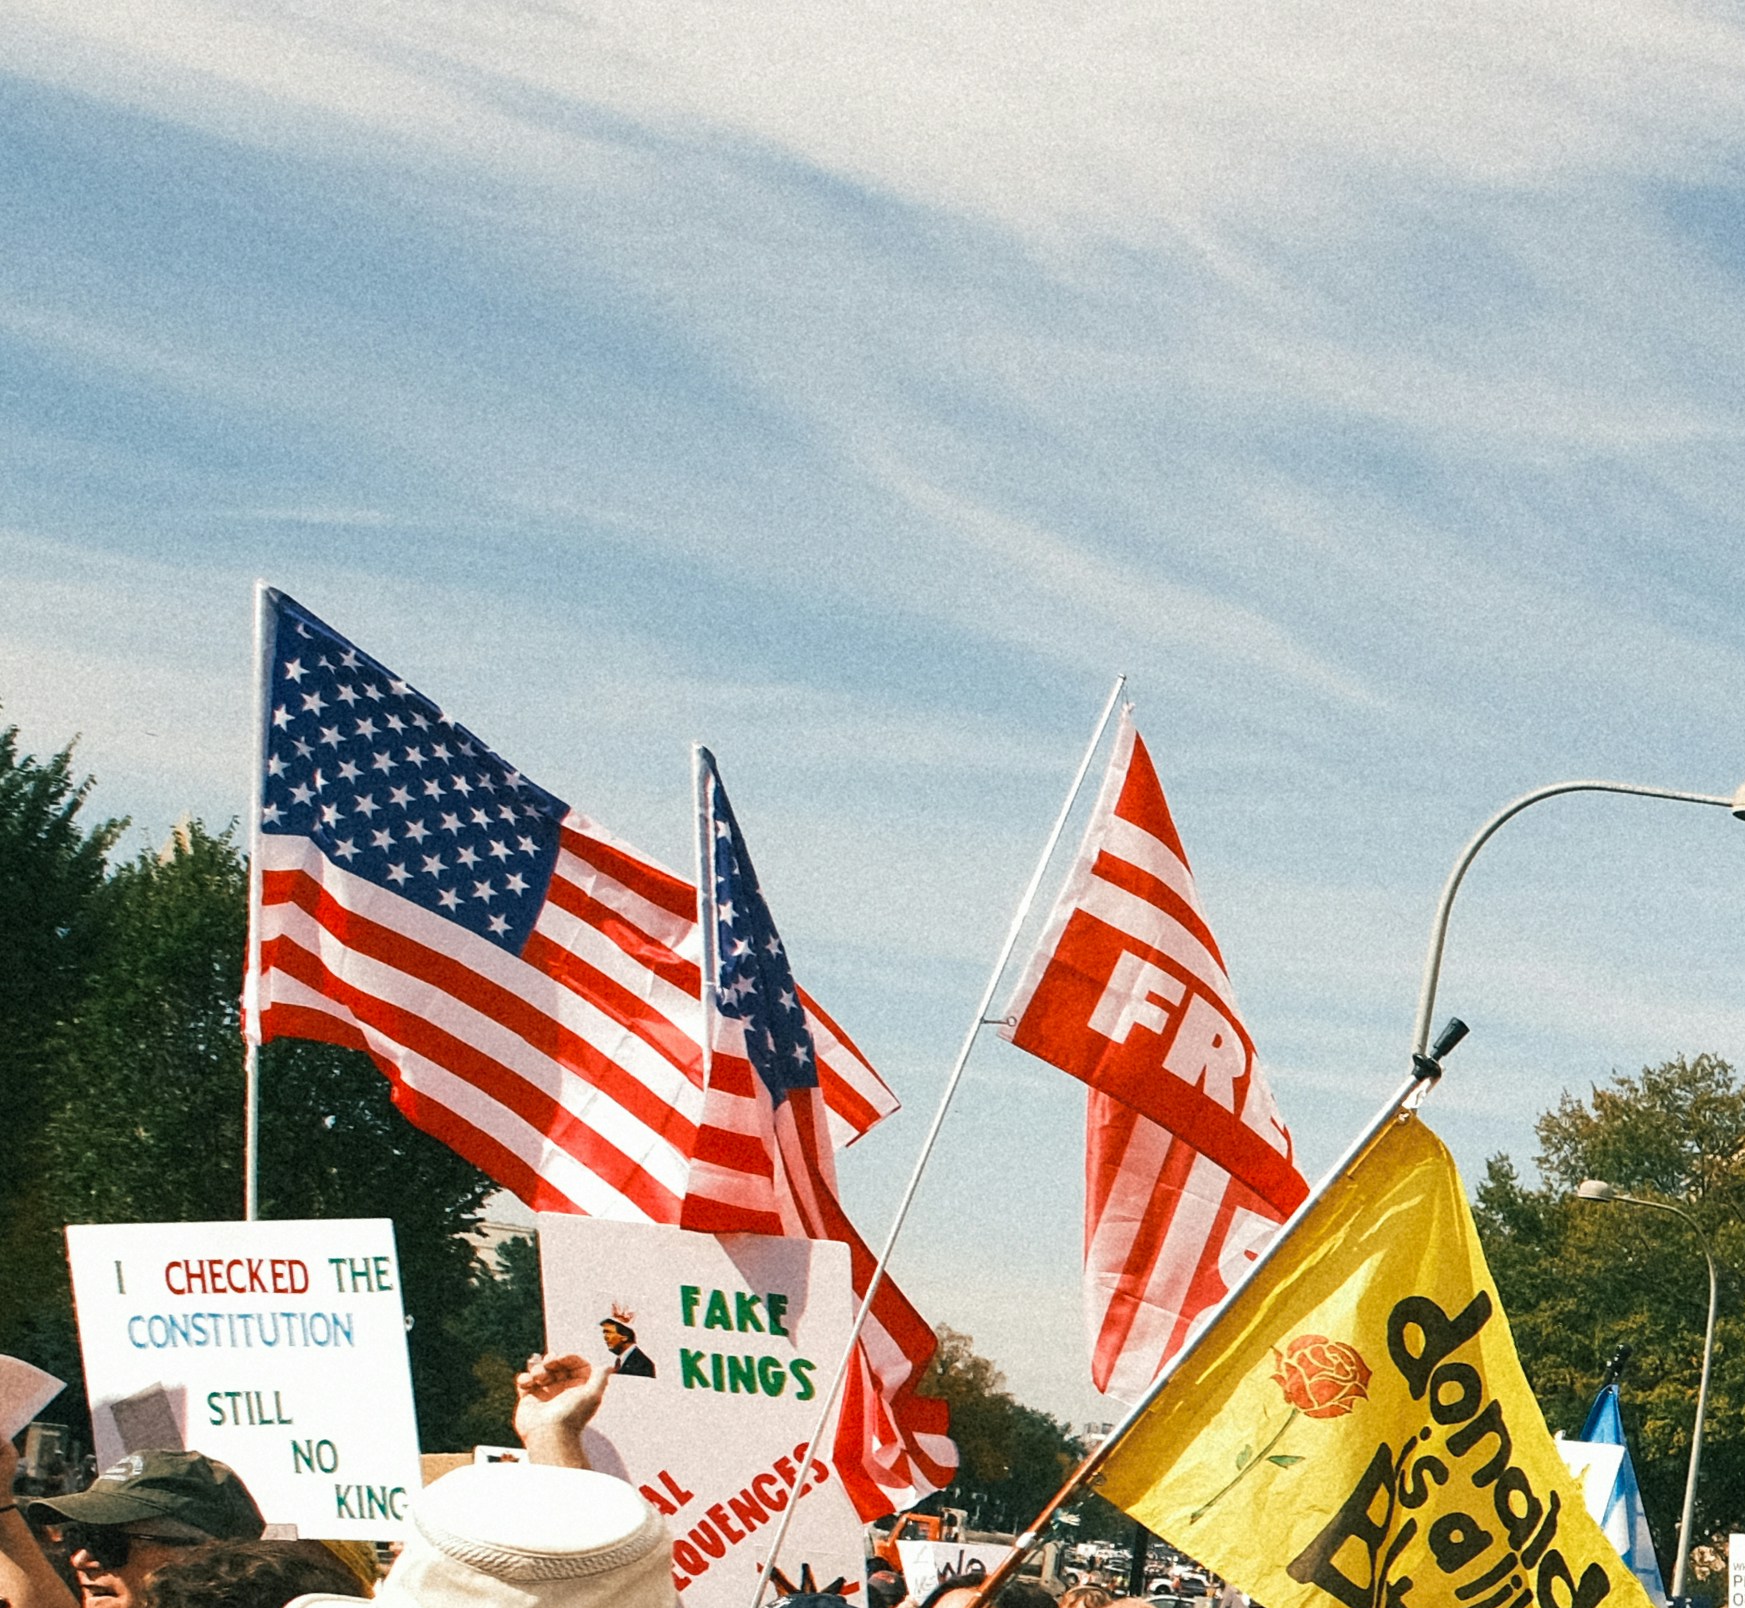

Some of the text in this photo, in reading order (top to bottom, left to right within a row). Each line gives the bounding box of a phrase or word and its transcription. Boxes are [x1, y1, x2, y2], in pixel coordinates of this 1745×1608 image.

[114, 1256, 394, 1296] I CHECKED THE
[679, 1284, 790, 1338] FAKE
[127, 1312, 355, 1349] CONSTITUTION
[678, 1347, 817, 1401] KINGS
[206, 1390, 293, 1426] STILL
[290, 1438, 339, 1475] NO
[334, 1484, 409, 1522] KING
